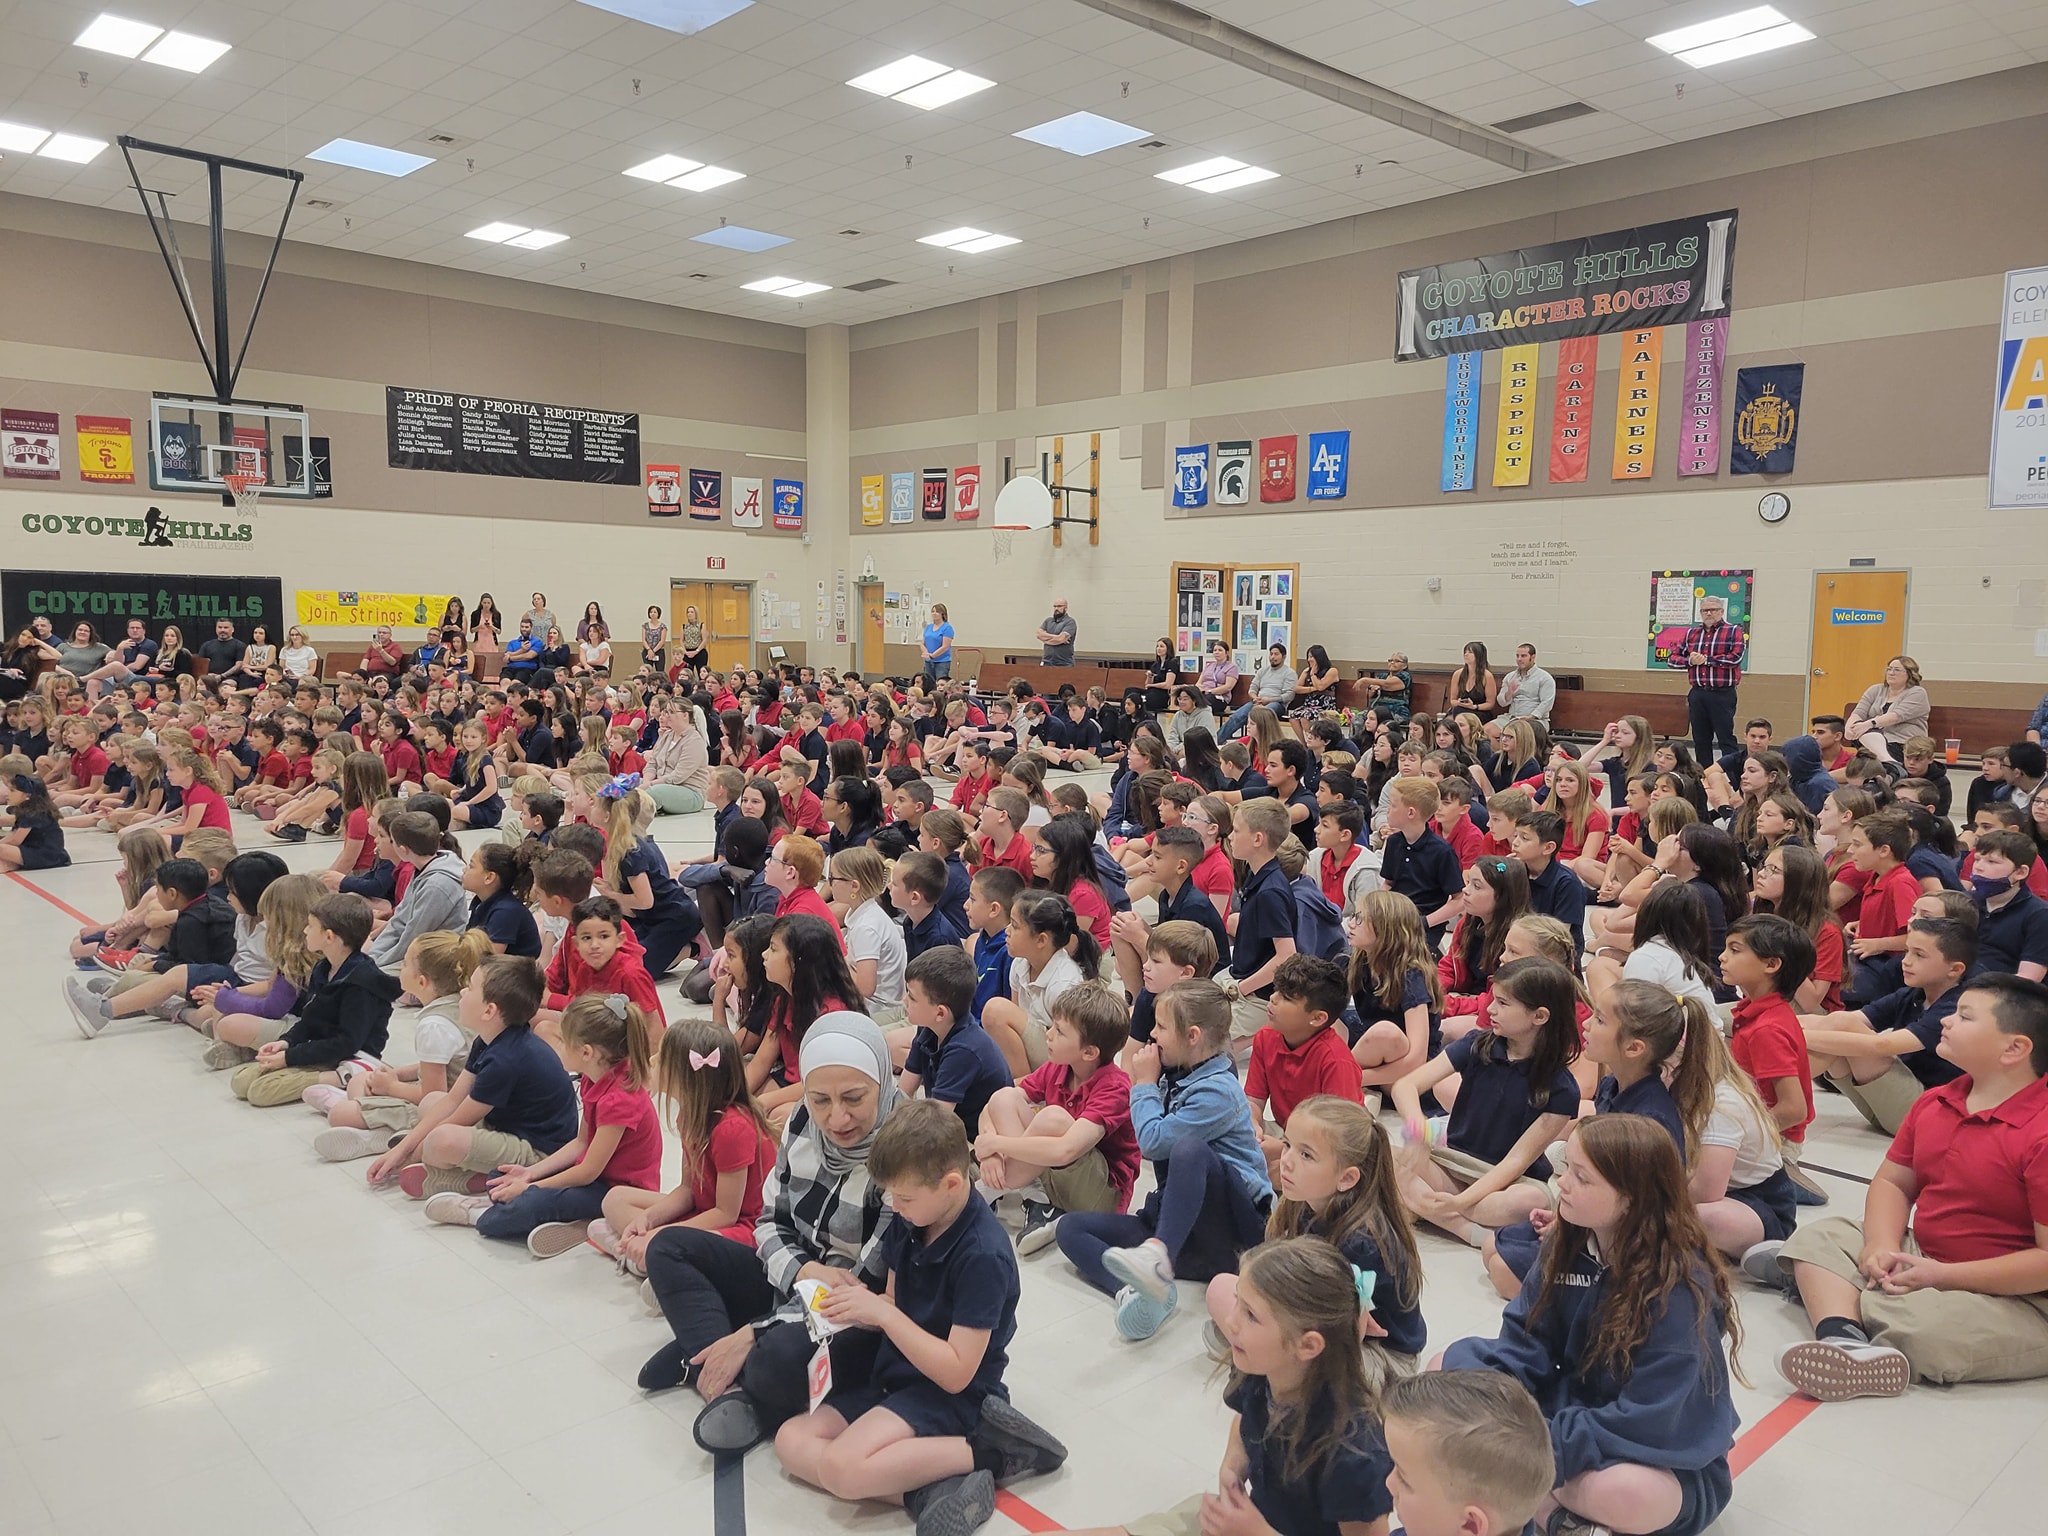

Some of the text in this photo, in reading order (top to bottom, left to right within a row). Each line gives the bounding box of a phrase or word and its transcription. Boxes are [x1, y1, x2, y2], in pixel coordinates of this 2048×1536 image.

[1423, 237, 1699, 310] COYOTE HILLS
[1425, 280, 1690, 340] CHARACTER ROCKS
[1626, 332, 1652, 474] FAIRNESS
[1692, 323, 1714, 471] CITIZENSHIP
[404, 391, 625, 426] PRIDE OF PEORIA RECIPIENTS
[462, 410, 482, 418] Candy
[1506, 362, 1528, 467] RESPECT
[1562, 362, 1584, 454] CARING
[422, 414, 453, 422] Apperson
[543, 420, 570, 428] Morrison
[1453, 352, 1470, 488] TRUSTWORTHINESS
[528, 431, 546, 439] Cindy
[88, 438, 122, 448] Trojans
[462, 444, 481, 452] Terry
[16, 446, 47, 456] STATE
[1312, 444, 1342, 482] AF
[84, 472, 131, 480] TROJANS
[2028, 466, 2048, 481] PE
[698, 480, 714, 498] V
[776, 485, 801, 496] KANSAS
[1314, 488, 1322, 496] AIR
[734, 488, 760, 518] A
[22, 514, 252, 542] COYOTE HILLS
[176, 539, 254, 551] TRAILBLAZERS
[1541, 550, 1578, 558] remember,
[710, 558, 722, 568] EXIT
[1526, 572, 1554, 580] Franklin
[28, 590, 263, 618] COYOTE HILLS
[308, 606, 402, 627] Join Strings
[1834, 612, 1883, 622] Welcome
